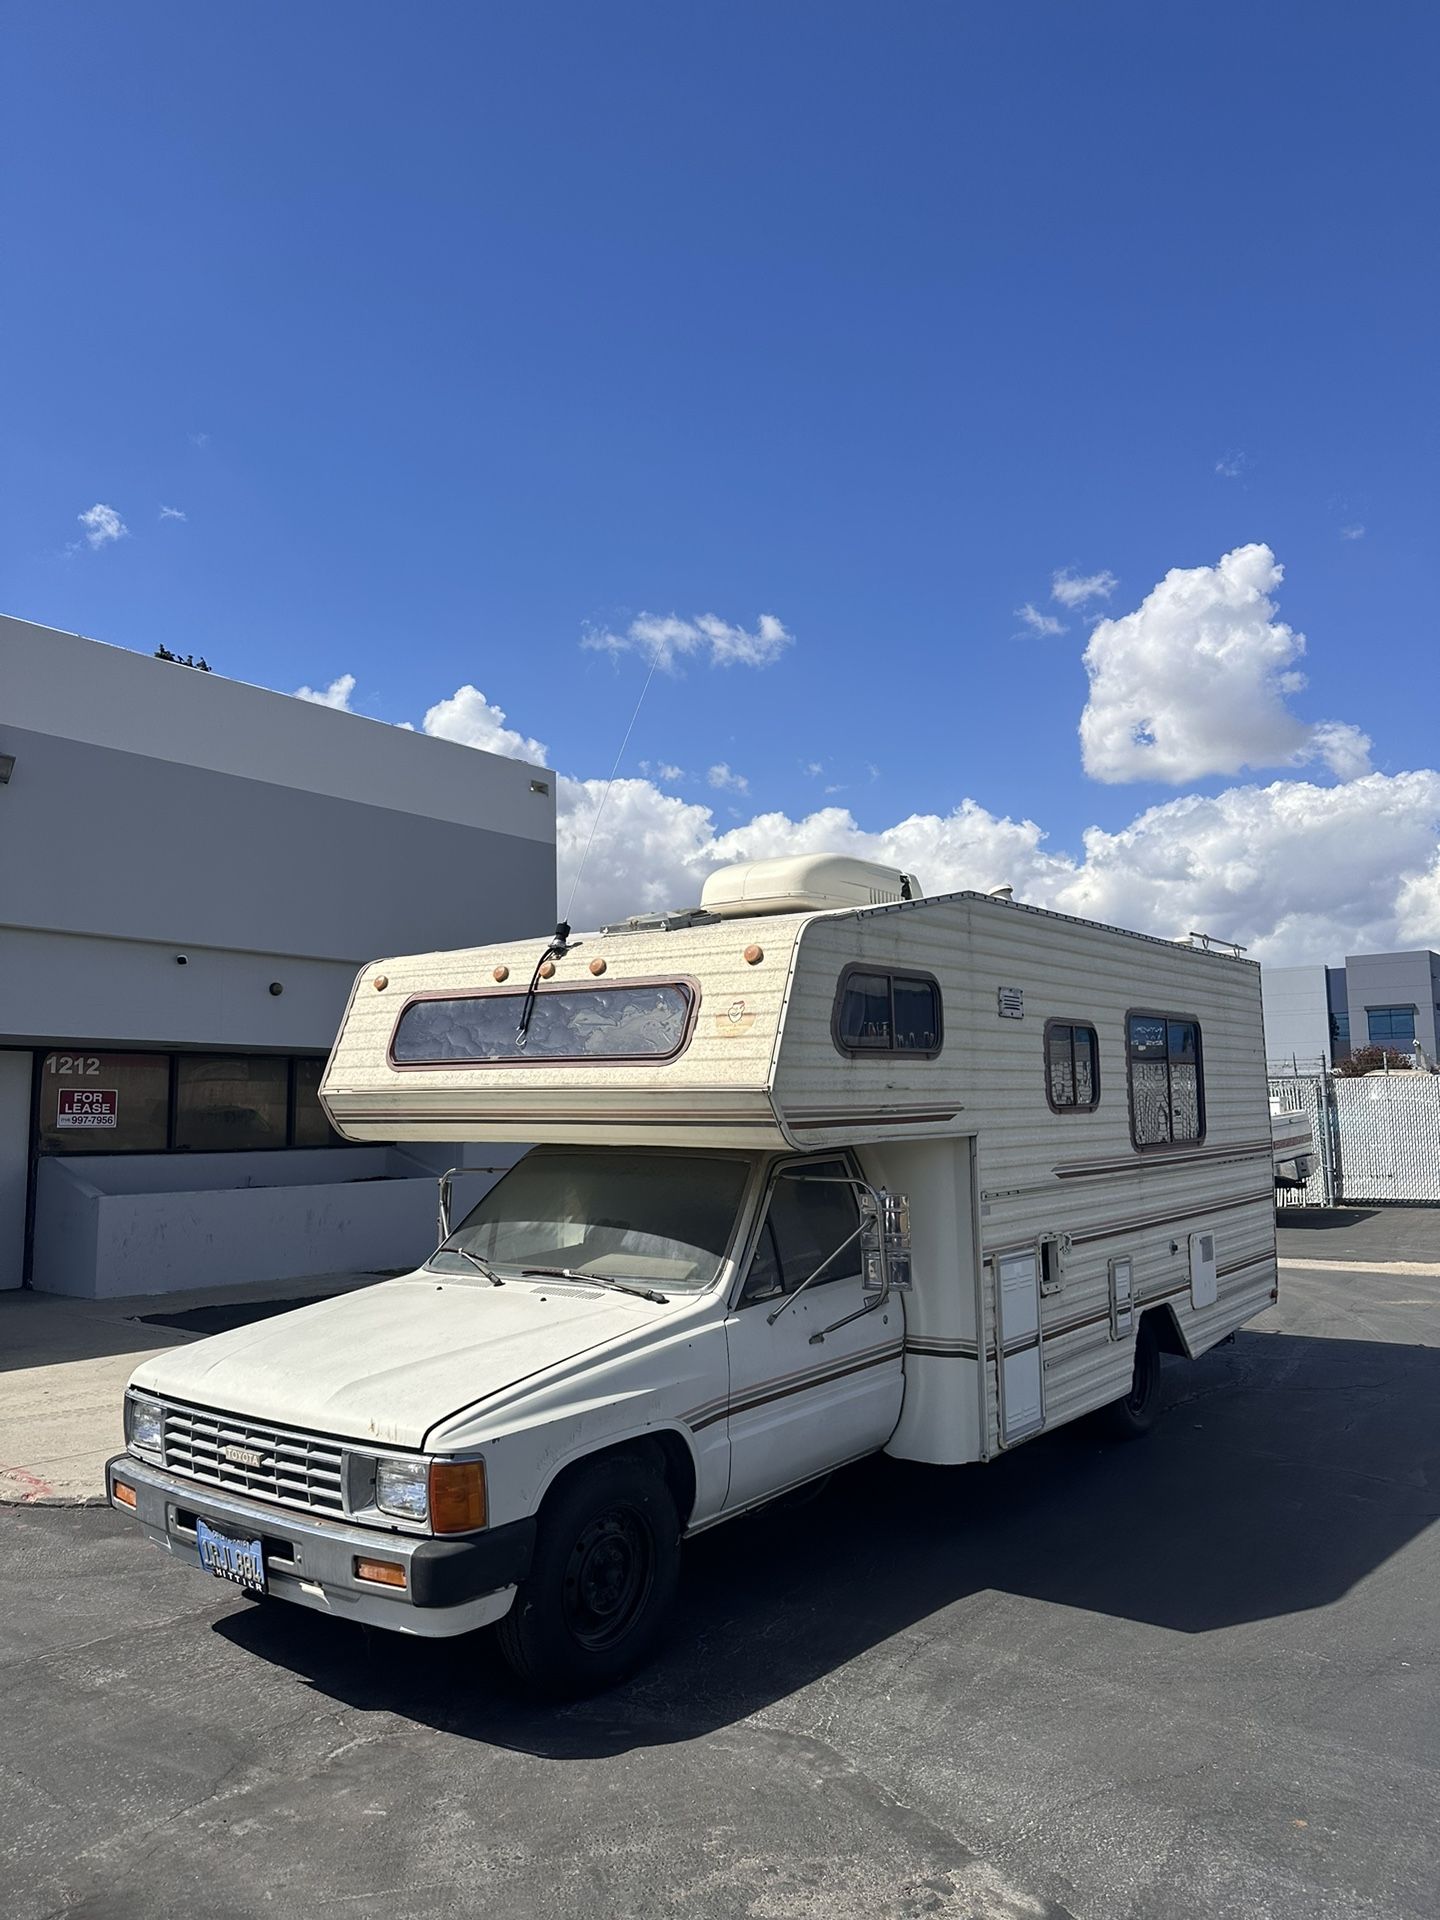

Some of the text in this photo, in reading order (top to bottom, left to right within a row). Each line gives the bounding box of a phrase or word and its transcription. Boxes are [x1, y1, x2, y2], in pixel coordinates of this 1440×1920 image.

[46, 1056, 100, 1075] 1212
[74, 1092, 103, 1103] FOR
[65, 1103, 111, 1114] LEASE
[71, 1115, 114, 1125] 997-7956
[226, 1448, 260, 1465] TOYOTA
